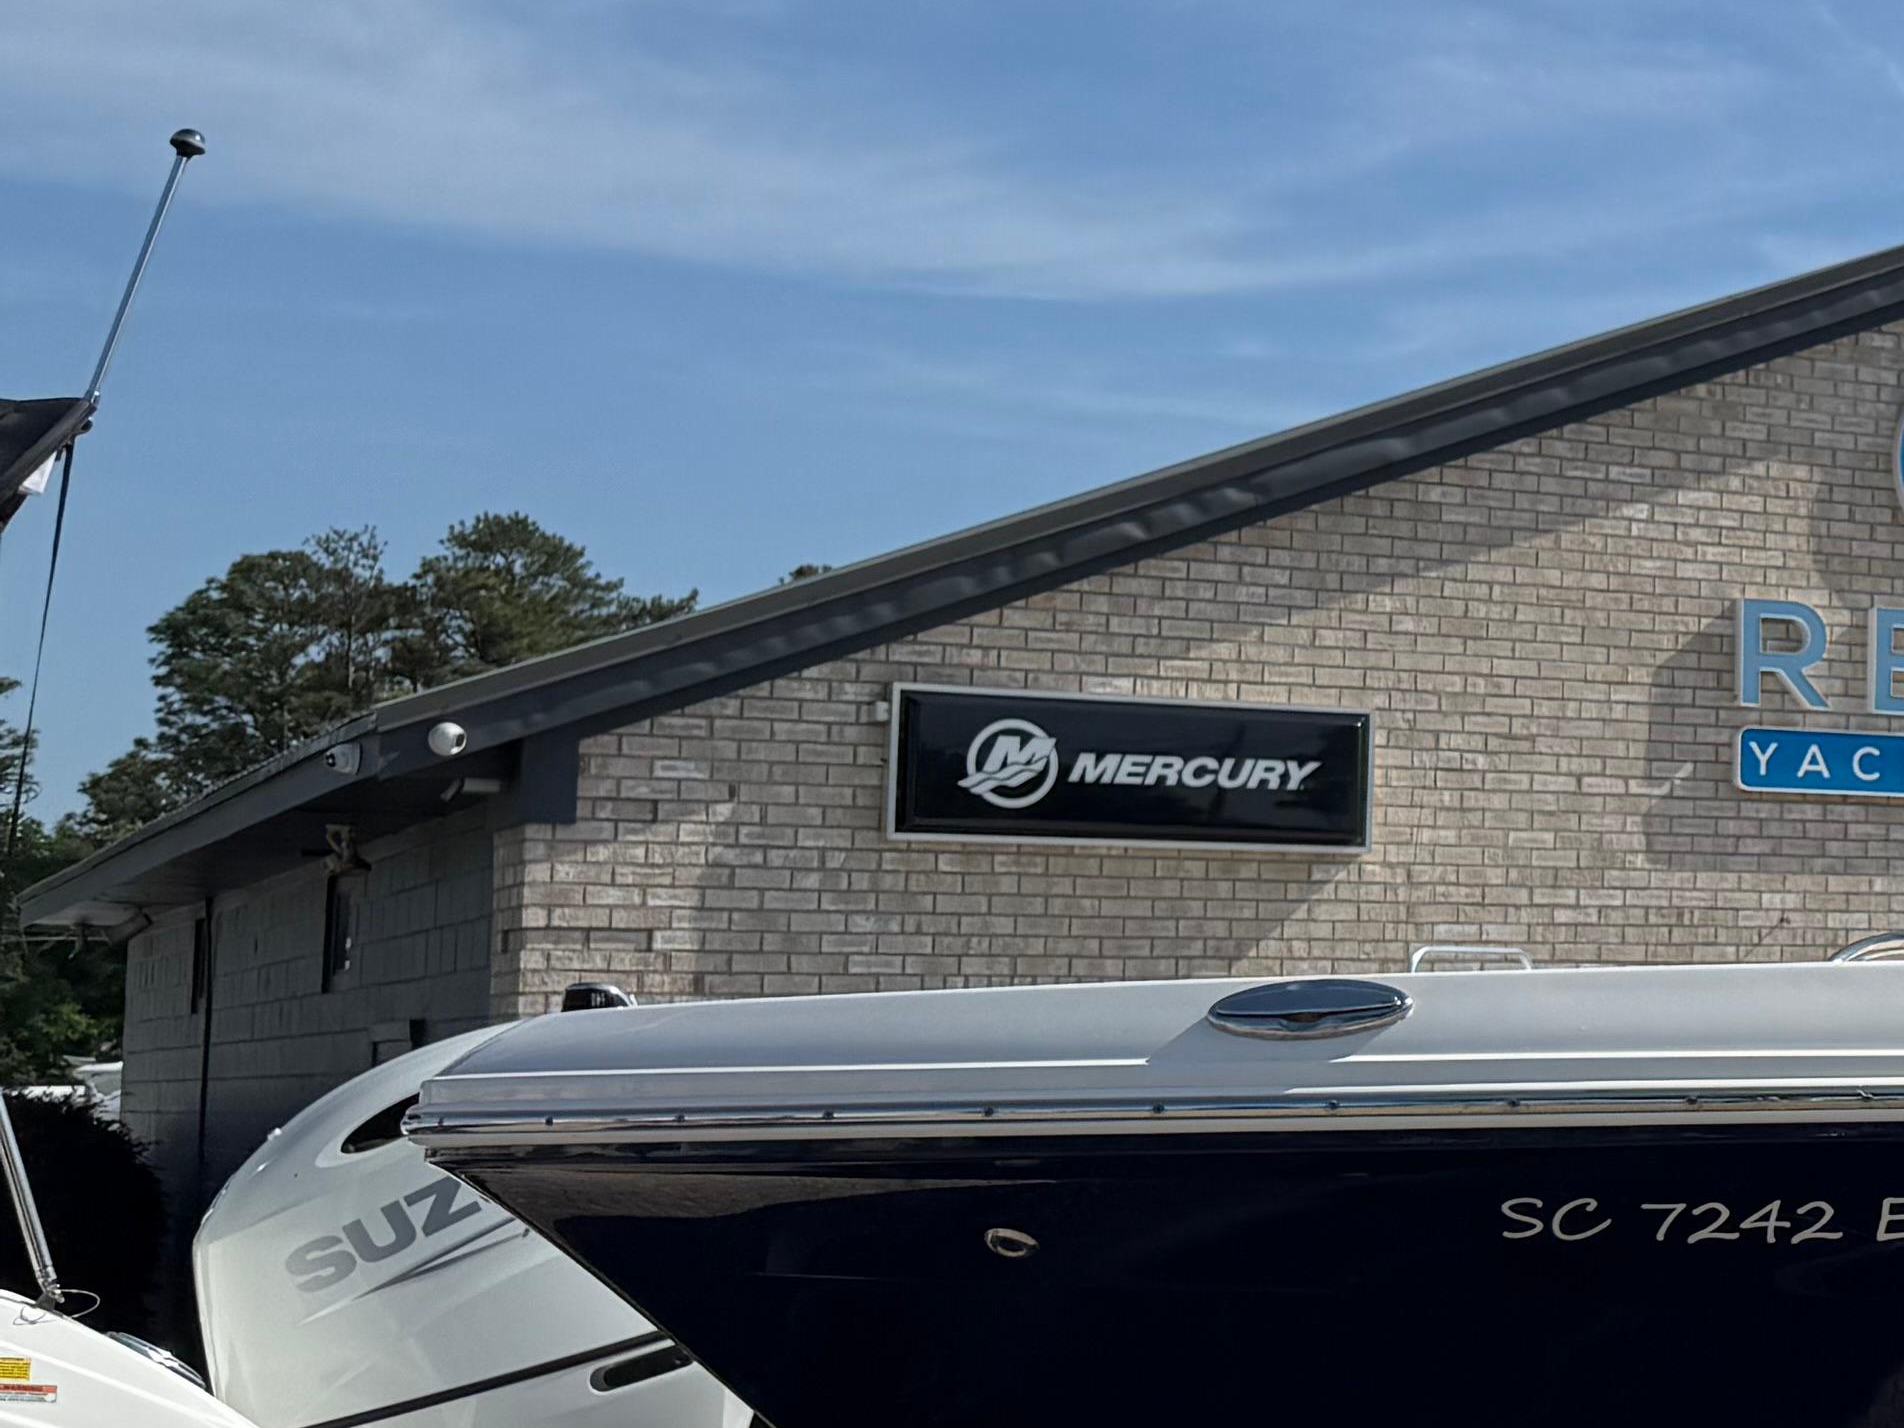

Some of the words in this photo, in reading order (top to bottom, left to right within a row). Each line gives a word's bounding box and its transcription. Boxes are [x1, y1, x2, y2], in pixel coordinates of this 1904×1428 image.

[1067, 752, 1322, 791] MERCURY
[285, 1175, 483, 1293] SUZ
[1499, 1197, 1612, 1241] SC
[1641, 1200, 1844, 1244] 7242
